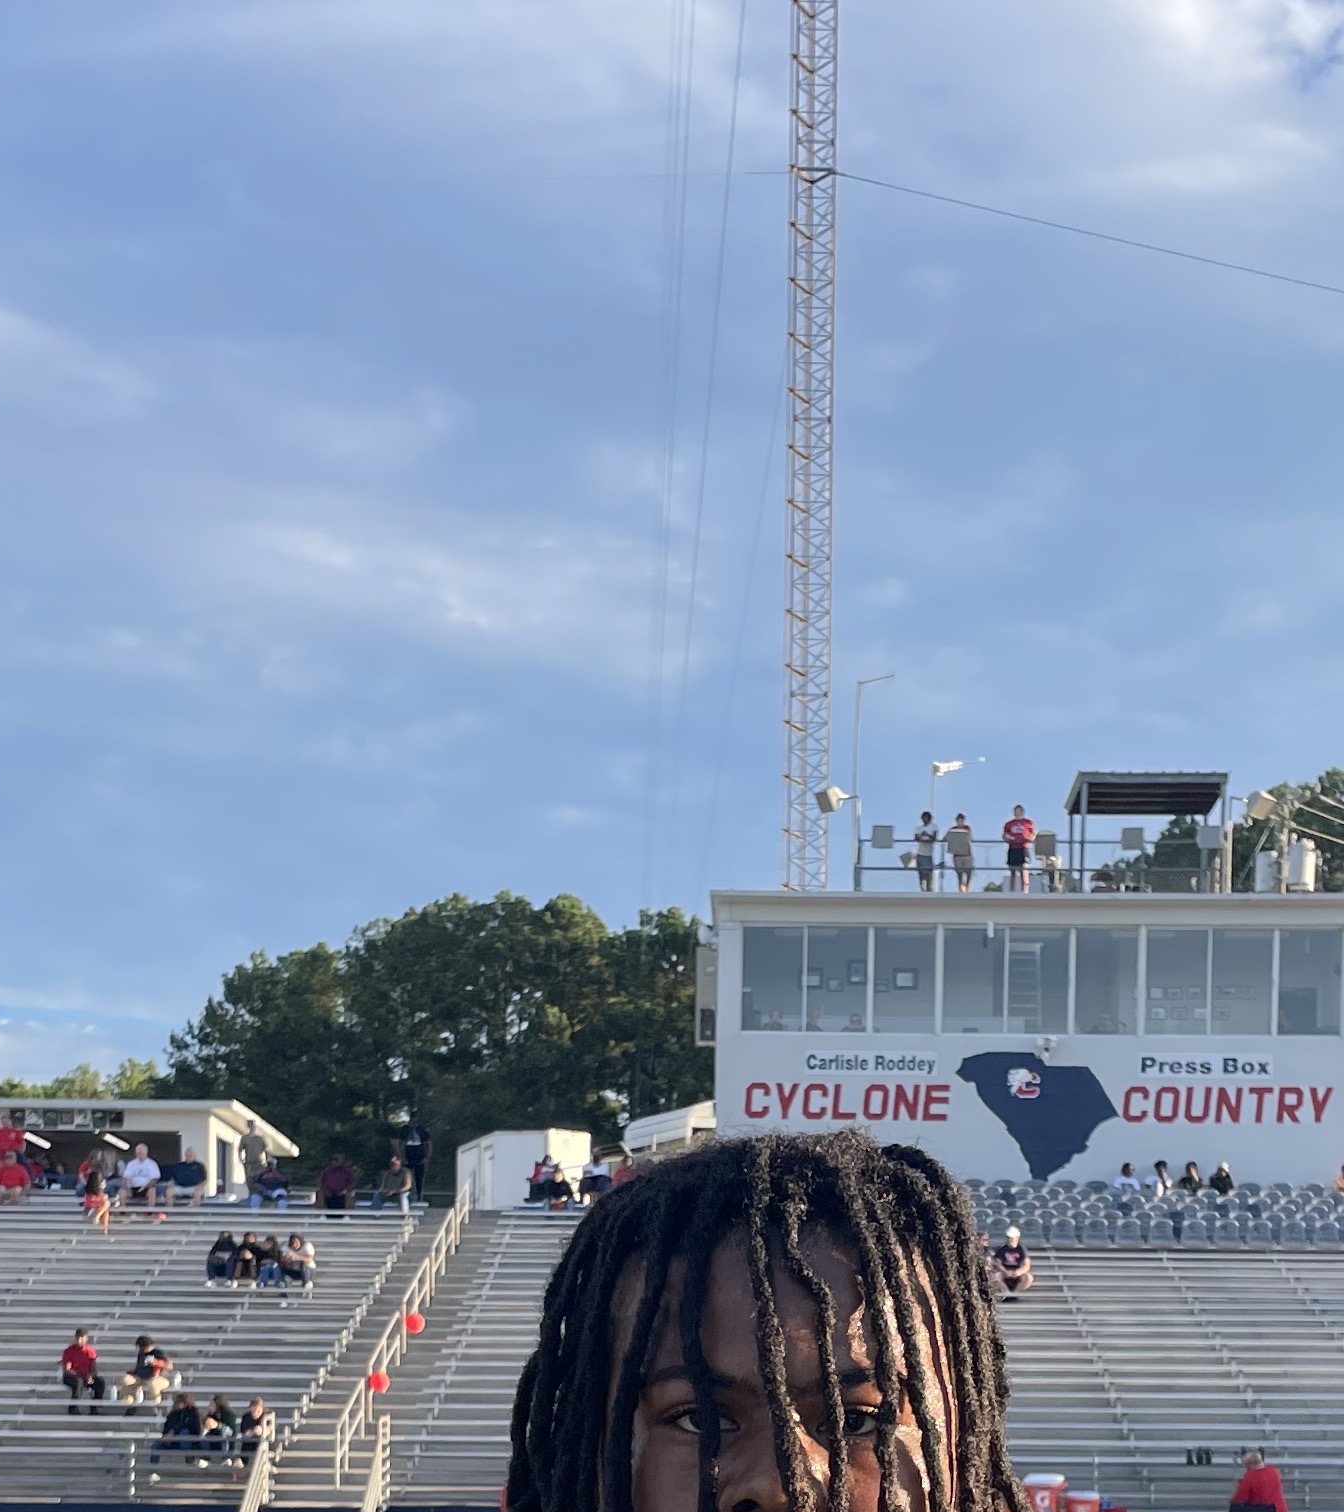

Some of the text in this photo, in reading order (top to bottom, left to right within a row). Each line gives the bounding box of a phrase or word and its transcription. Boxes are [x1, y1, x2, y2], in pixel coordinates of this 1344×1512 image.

[806, 1054, 1270, 1076] Carlisle Roddey Press Box
[744, 1081, 1335, 1125] CYCLONE COUNTRY
